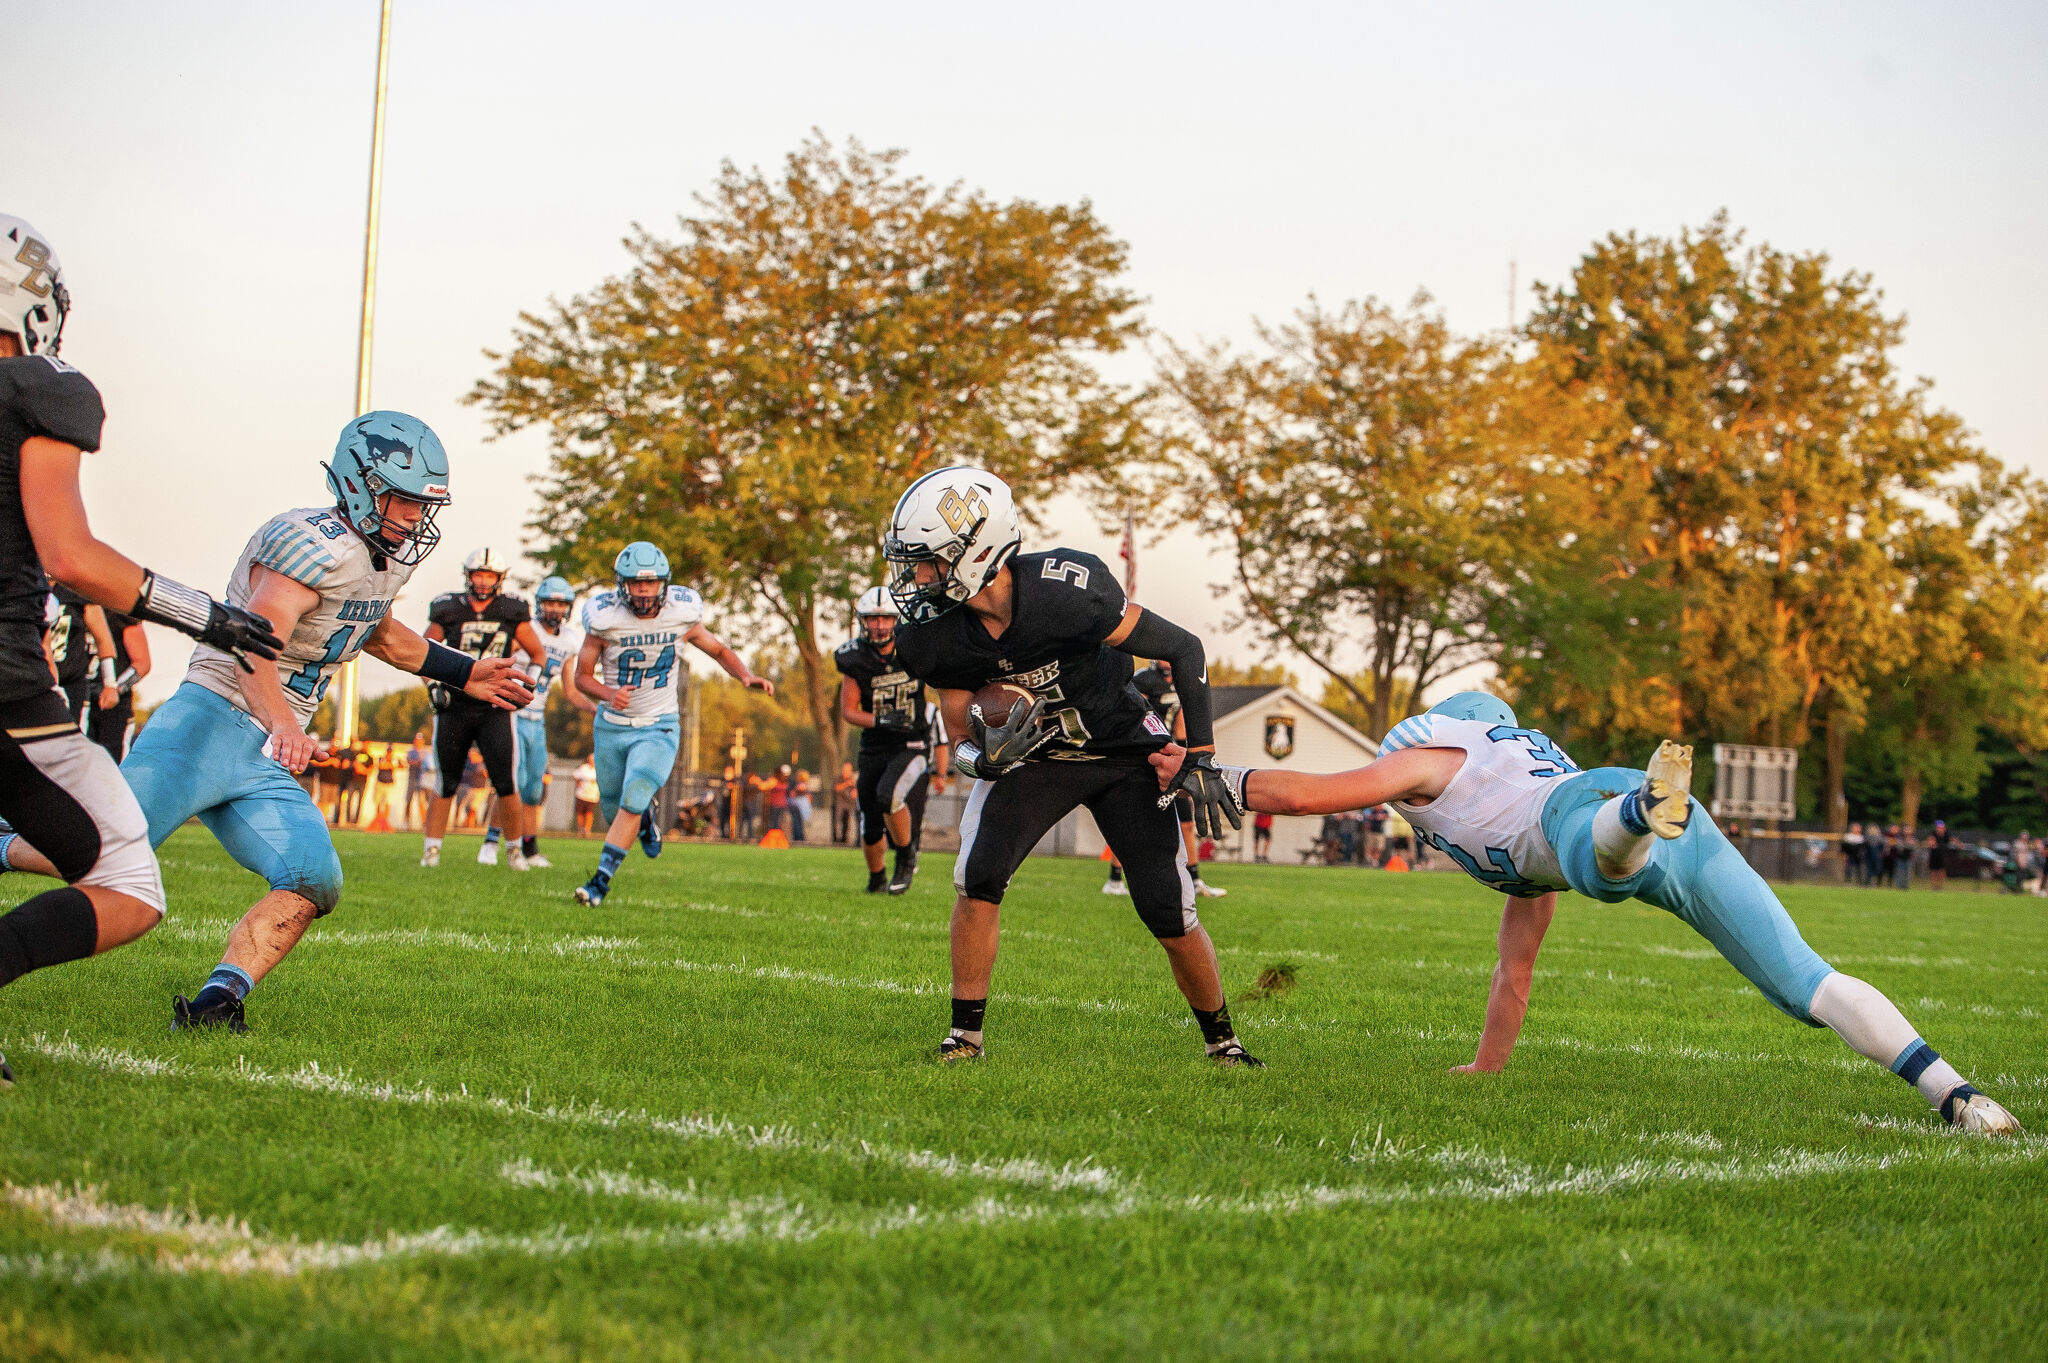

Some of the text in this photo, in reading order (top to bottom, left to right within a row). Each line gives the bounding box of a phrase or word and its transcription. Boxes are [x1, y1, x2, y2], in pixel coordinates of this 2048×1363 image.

[305, 512, 348, 540] 13
[936, 486, 989, 537] BC
[1041, 558, 1090, 590] 5
[620, 633, 678, 647] MERIDIAN
[617, 645, 676, 689] 64
